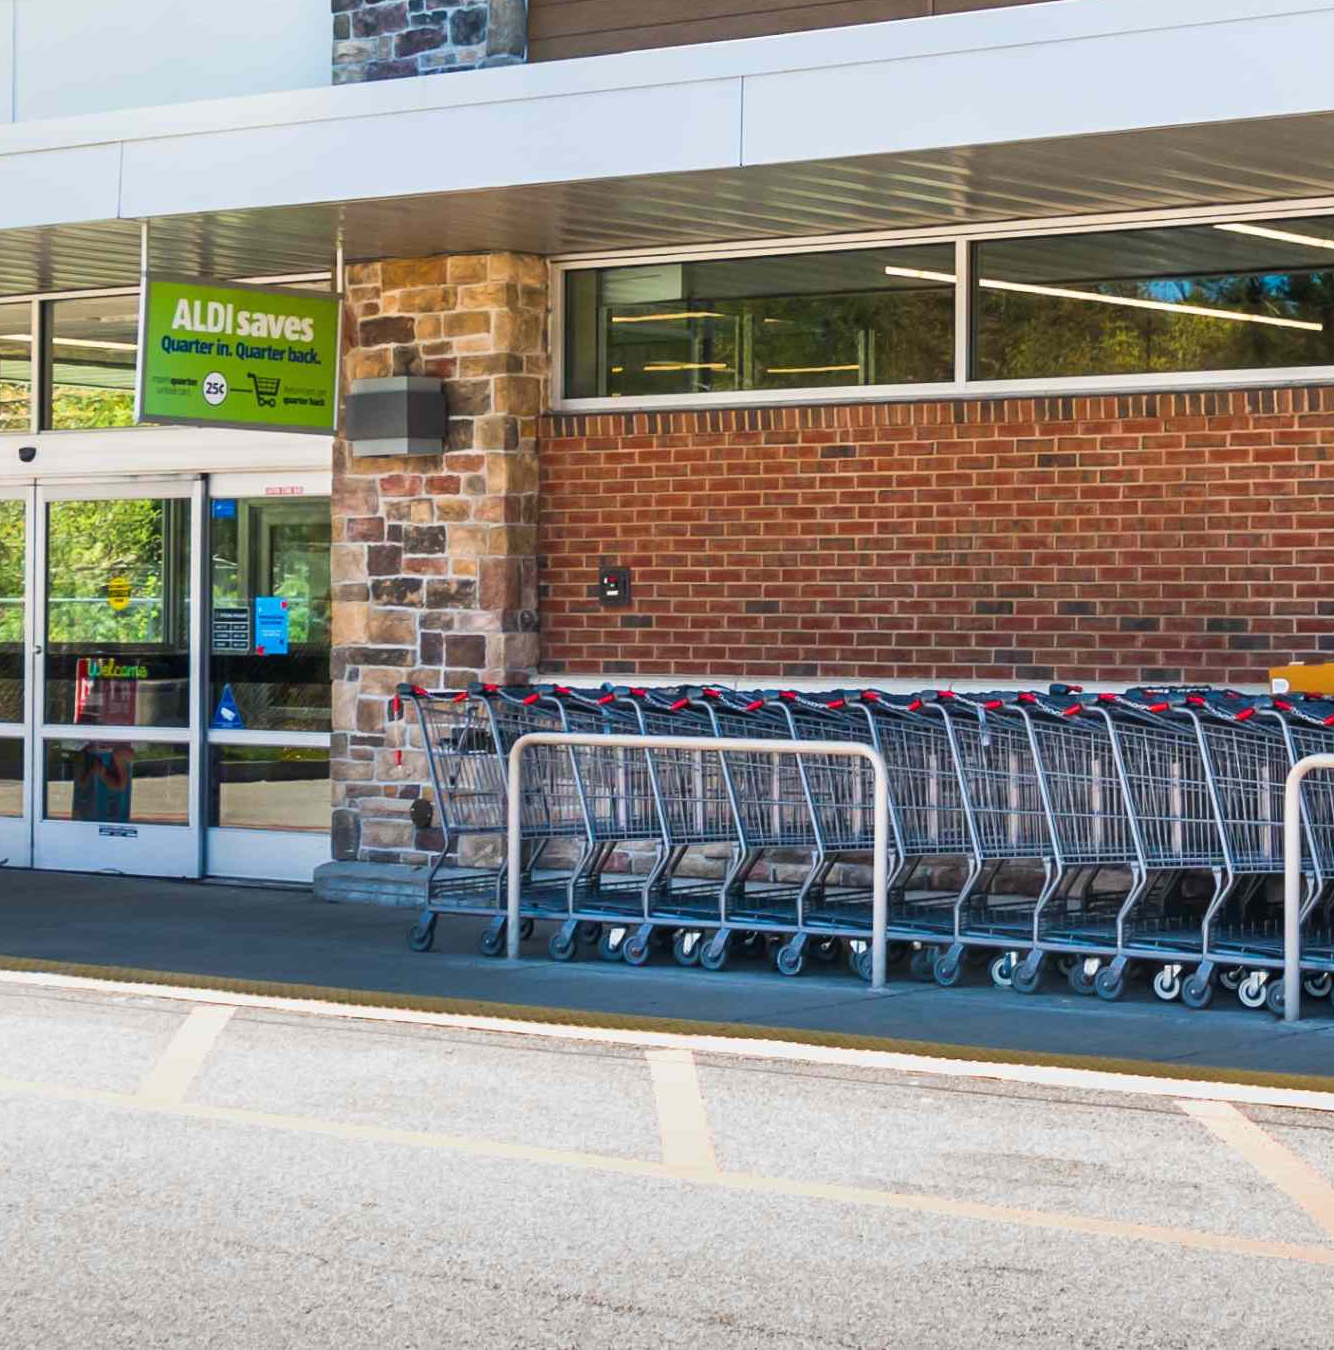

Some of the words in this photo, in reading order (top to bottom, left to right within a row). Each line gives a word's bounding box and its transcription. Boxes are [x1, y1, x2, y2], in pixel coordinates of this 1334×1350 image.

[171, 298, 233, 334] ALDI
[236, 310, 315, 343] saves
[161, 335, 214, 355] Quarter
[216, 338, 233, 356] in.
[235, 341, 284, 361] Quarter
[287, 346, 322, 365] back.
[85, 657, 148, 679] Welcome
